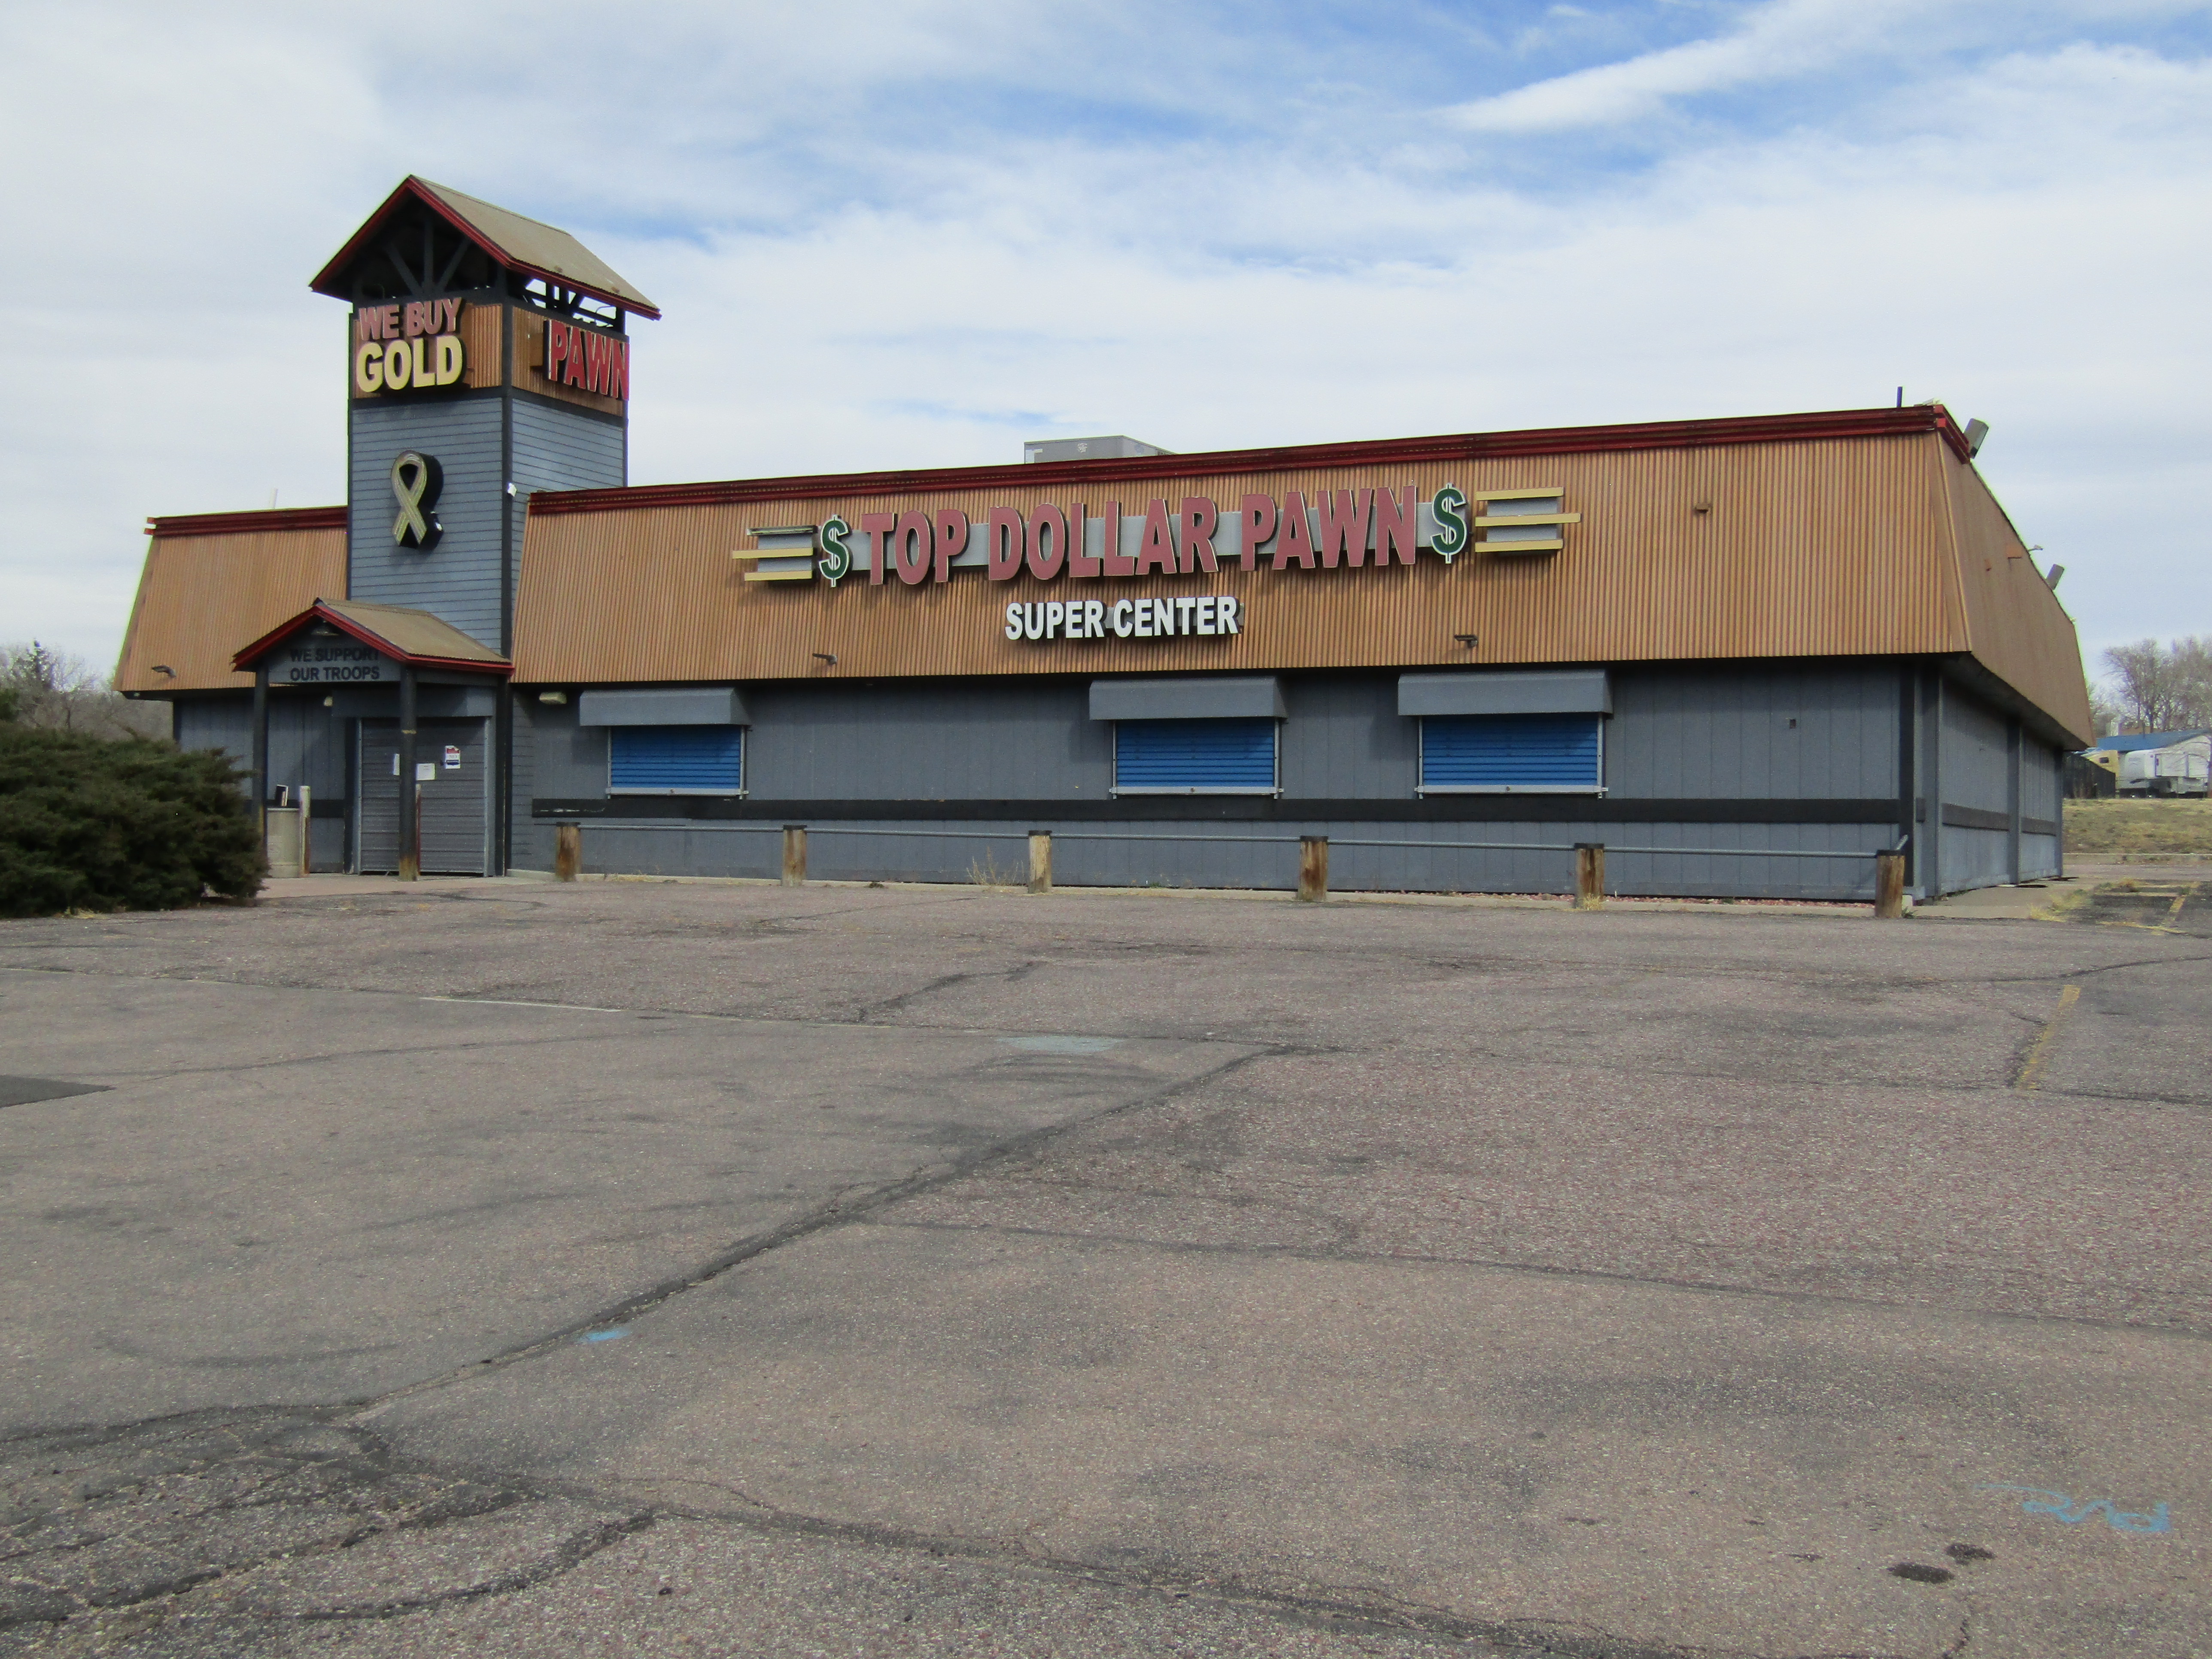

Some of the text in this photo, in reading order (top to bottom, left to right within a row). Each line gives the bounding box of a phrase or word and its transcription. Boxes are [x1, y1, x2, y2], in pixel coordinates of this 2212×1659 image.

[359, 297, 462, 340] WE BUY
[356, 335, 463, 392] GOLD
[549, 319, 630, 401] PAWN
[988, 496, 1219, 580] DOLLAR
[1240, 485, 1417, 571] PAWN
[1005, 596, 1238, 640] SUPER CENTER
[290, 647, 380, 662] WE SUPPORT
[290, 666, 380, 681] OUR TROOPS
